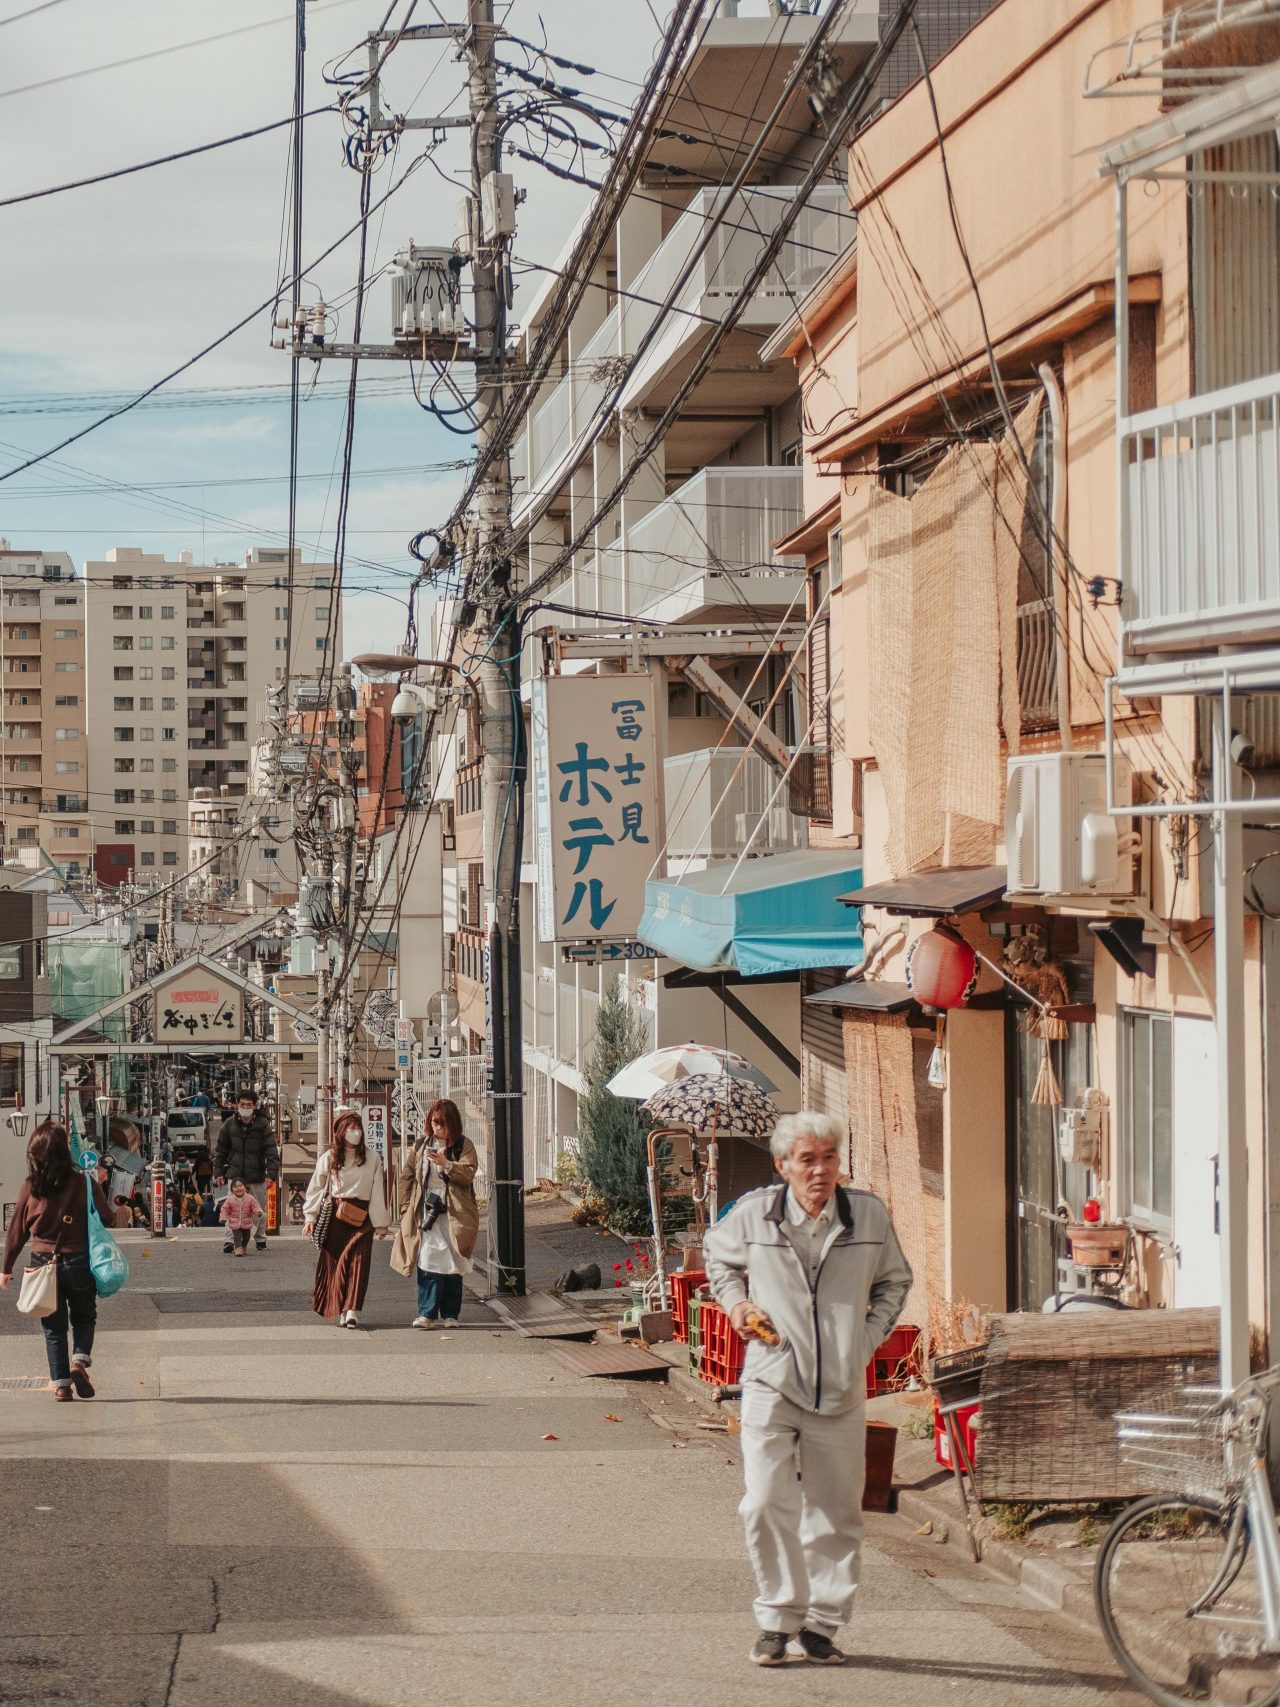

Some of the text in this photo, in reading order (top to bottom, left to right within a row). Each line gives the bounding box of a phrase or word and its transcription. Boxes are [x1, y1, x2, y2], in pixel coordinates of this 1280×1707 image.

[556, 742, 618, 931] ホテル
[623, 942, 657, 959] 30M
[163, 1000, 235, 1036] 谷中ぎんざ
